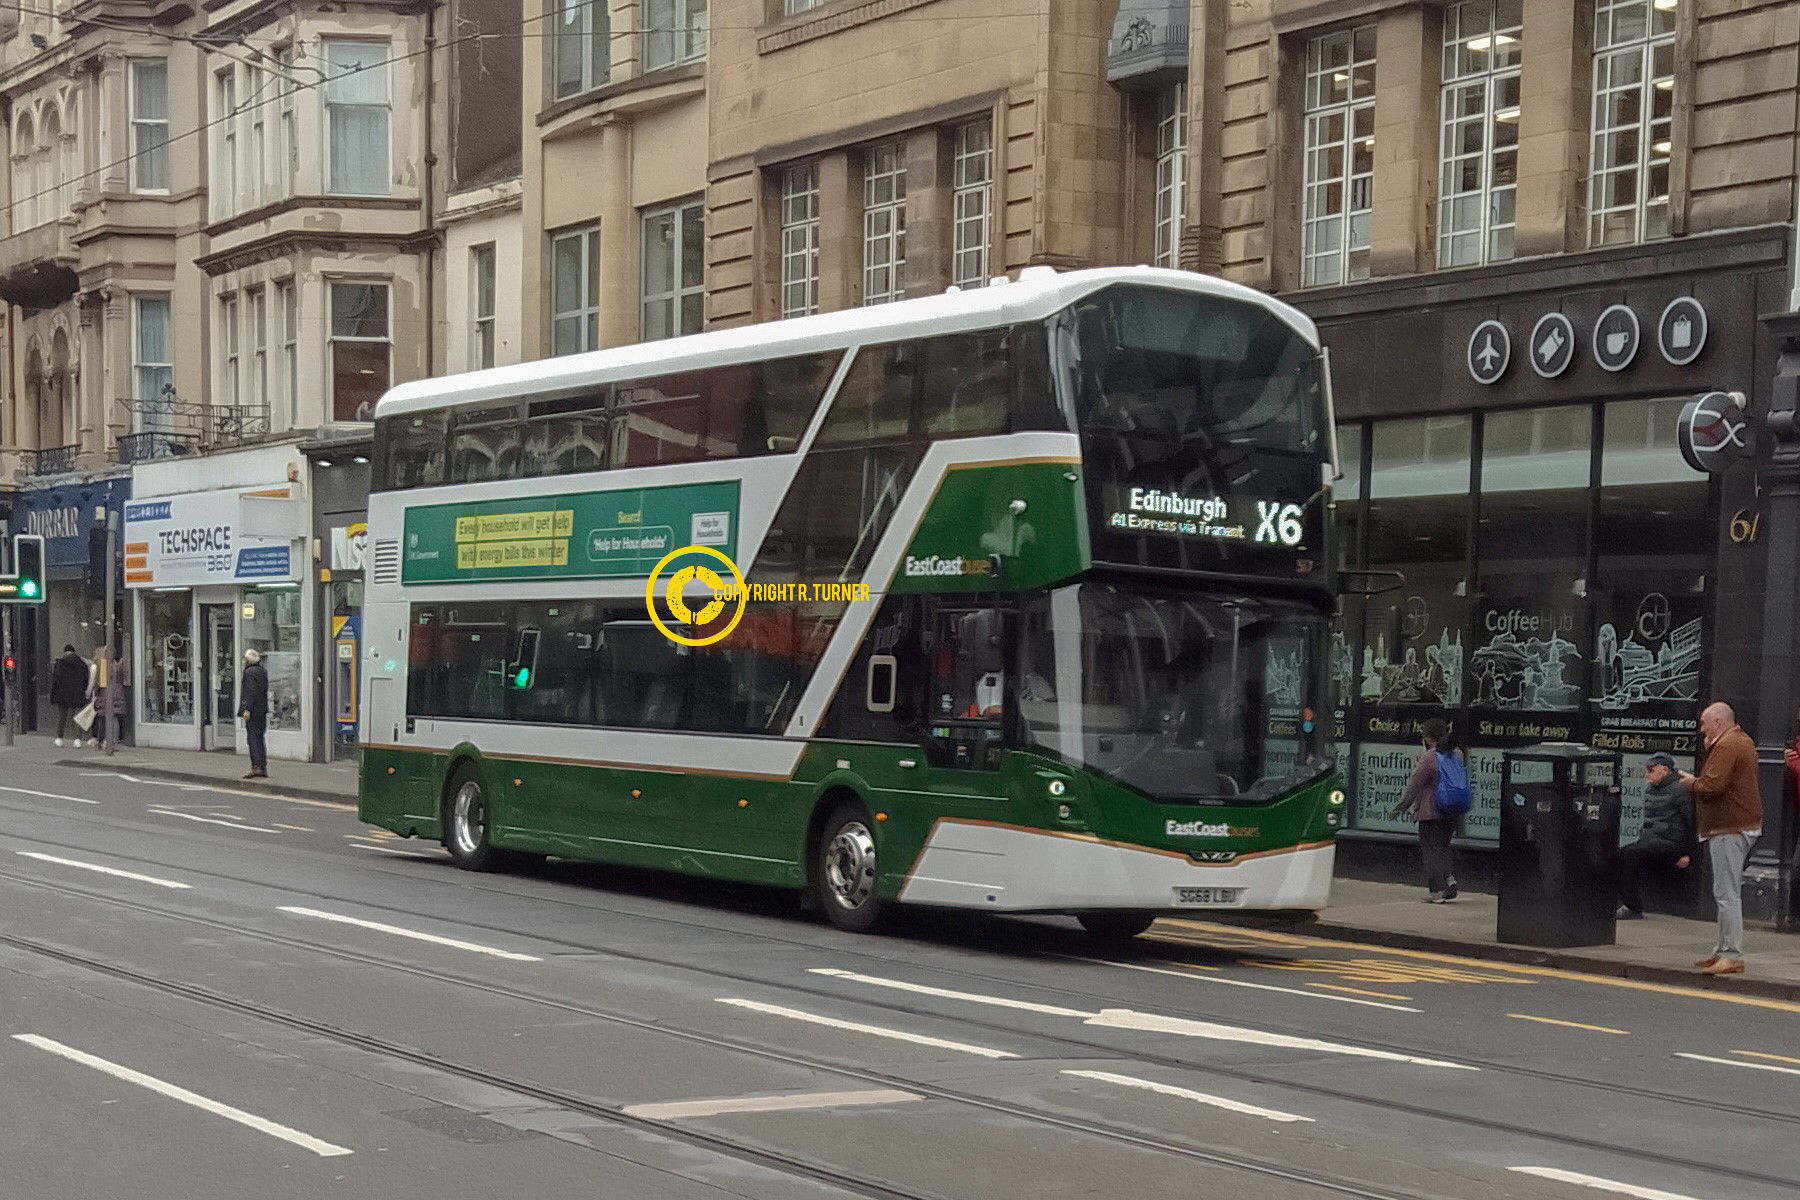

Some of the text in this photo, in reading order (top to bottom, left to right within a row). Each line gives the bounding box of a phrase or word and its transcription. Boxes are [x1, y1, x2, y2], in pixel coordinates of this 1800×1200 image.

[1130, 488, 1227, 521] Edinburgh
[1128, 514, 1177, 532] Express
[1178, 519, 1197, 534] via
[1255, 501, 1303, 545] X6
[1730, 508, 1759, 542] 61
[159, 526, 231, 554] TECHSPACE
[1479, 720, 1493, 735] Sit
[1519, 722, 1542, 738] take
[1542, 726, 1571, 739] away
[1620, 718, 1658, 728] BREAKFAST
[1658, 719, 1670, 728] ON
[1685, 720, 1697, 729] GO
[1592, 732, 1619, 749] Filled
[1621, 734, 1646, 750] Rolls
[1367, 751, 1412, 769] muffin
